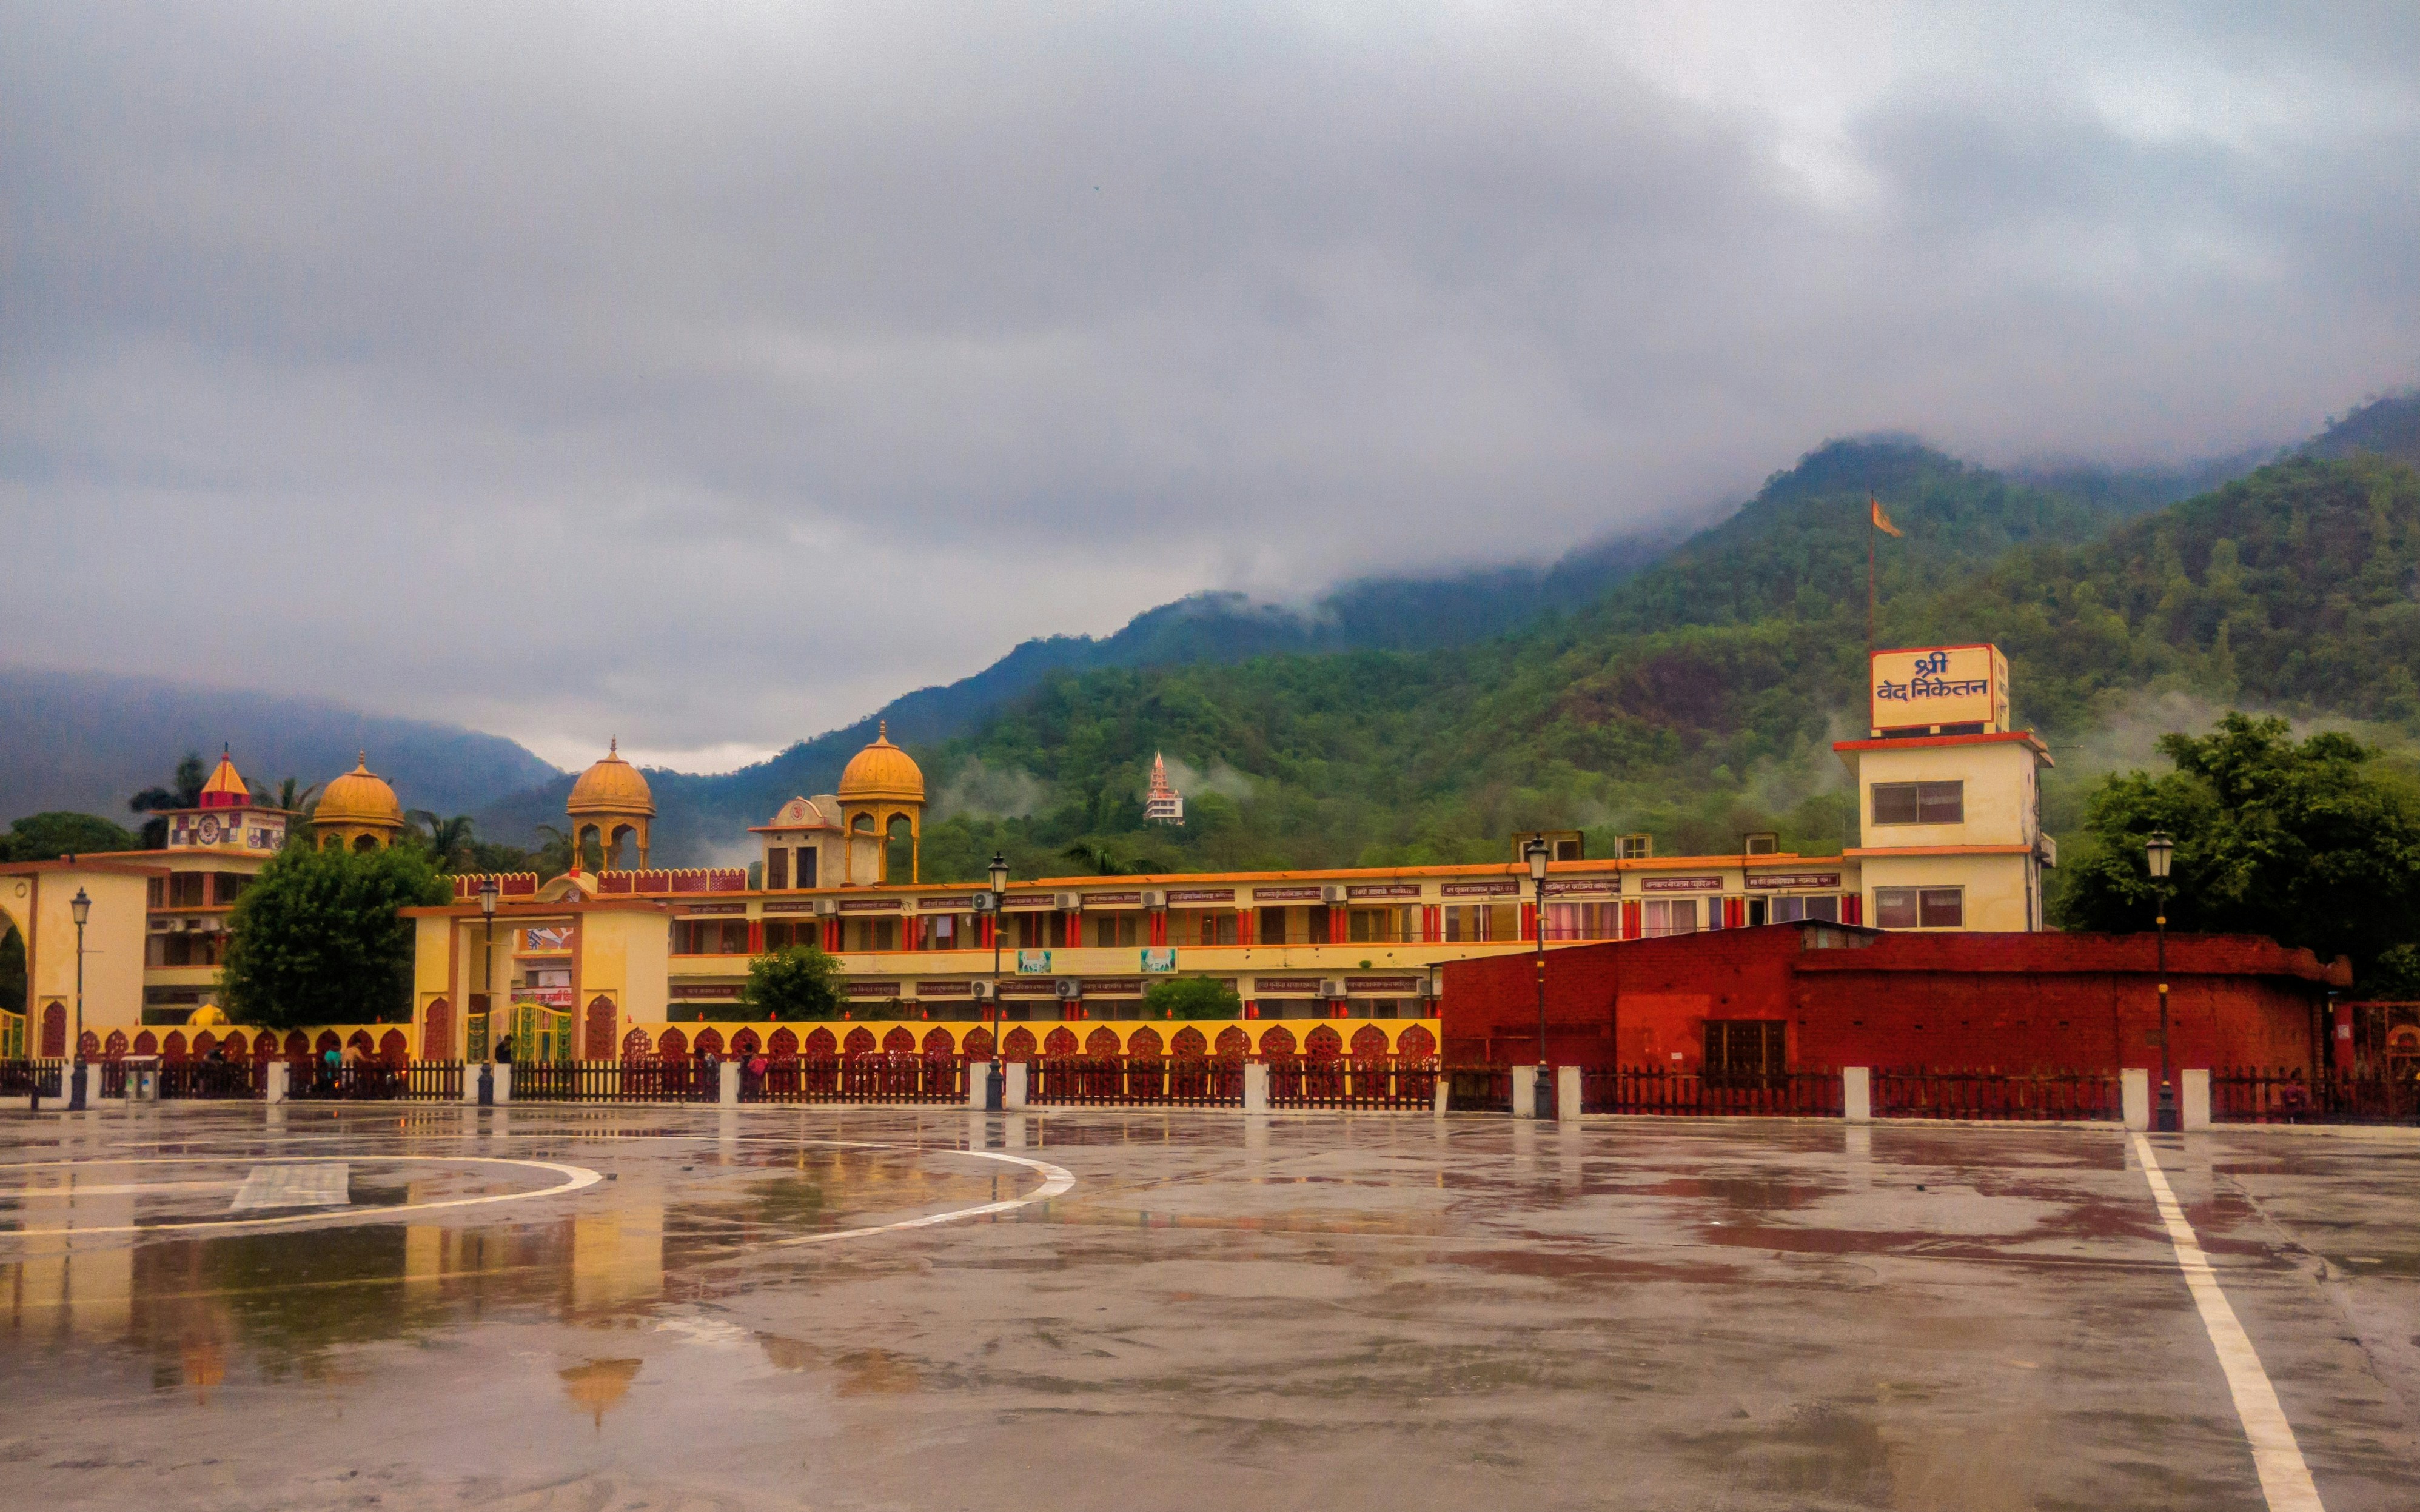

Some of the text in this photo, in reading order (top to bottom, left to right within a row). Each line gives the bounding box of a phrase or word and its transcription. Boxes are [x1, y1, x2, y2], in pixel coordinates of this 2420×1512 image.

[1914, 651, 1948, 678] श्री
[1877, 680, 1908, 701] वेद
[1911, 677, 1989, 698] निकेतन
